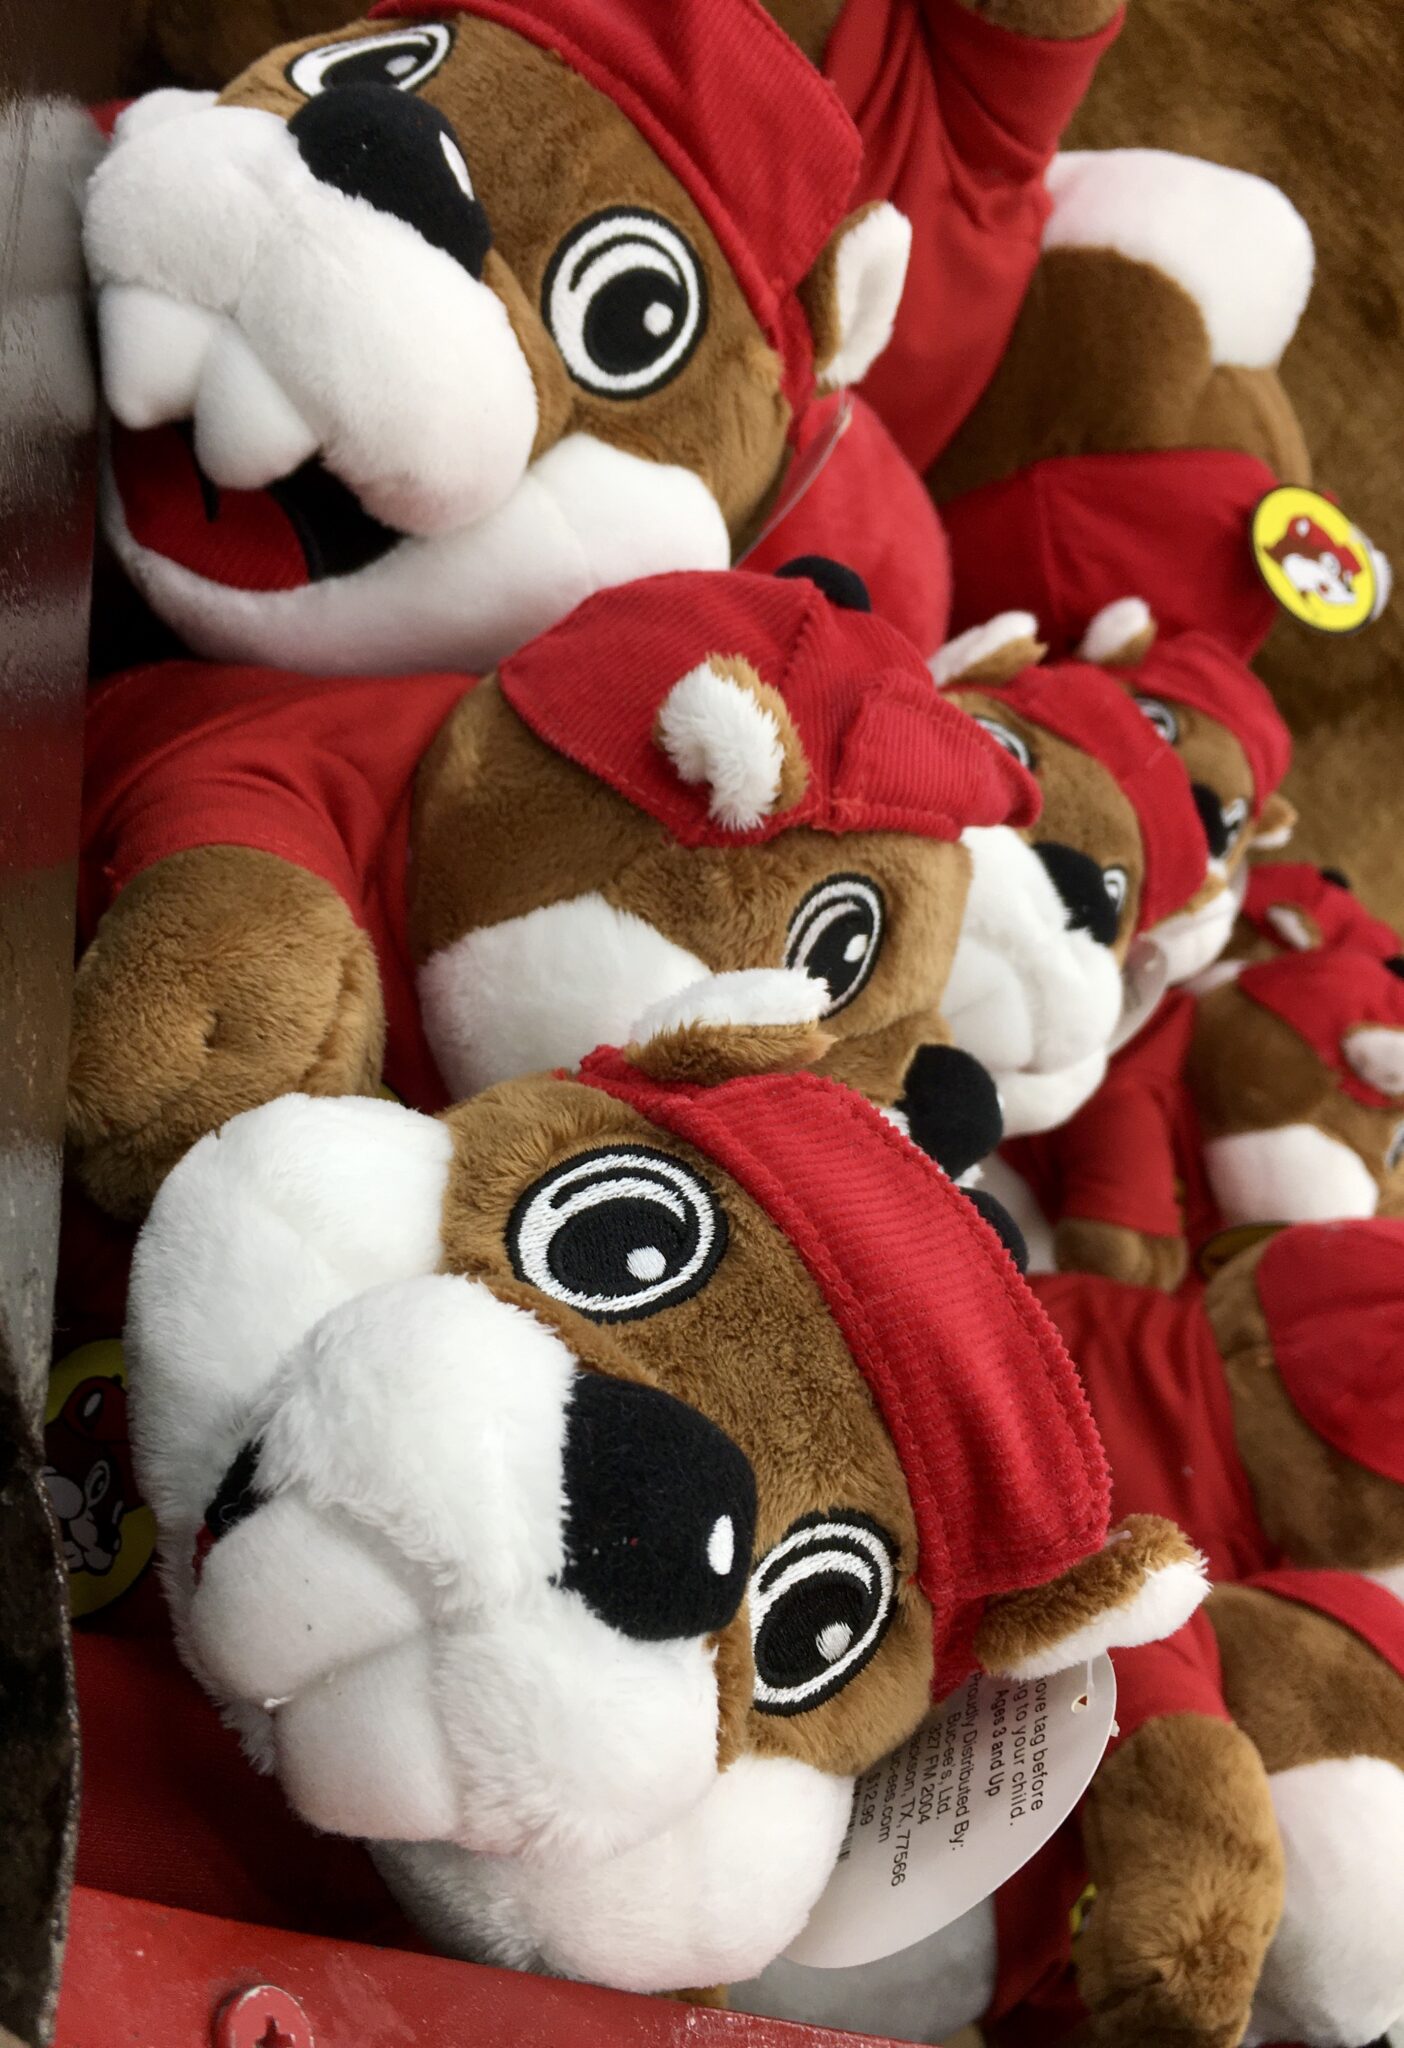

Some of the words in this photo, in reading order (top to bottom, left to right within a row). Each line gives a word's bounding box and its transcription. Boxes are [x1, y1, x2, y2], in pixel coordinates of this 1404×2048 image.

[961, 1672, 983, 1727] Proudly
[991, 1689, 1009, 1726] Ages
[1016, 1703, 1029, 1722] to
[927, 1722, 942, 1749] 327
[938, 1711, 961, 1785] Buc-ee's,
[992, 1726, 1007, 1738] 3
[1011, 1724, 1026, 1765] your
[1030, 1715, 1048, 1746] tag
[923, 1754, 939, 1781] FM
[990, 1741, 1005, 1771] and
[955, 1730, 978, 1818] Distributed
[984, 1771, 1005, 1797] Up
[1031, 1747, 1048, 1811] before
[860, 1772, 881, 1826] $12.99
[896, 1796, 915, 1828] TX,
[917, 1783, 935, 1825] 2004
[936, 1786, 953, 1820] Ltd.
[1010, 1771, 1027, 1826] child.
[949, 1819, 969, 1851] By:
[891, 1829, 911, 1887] 77566
